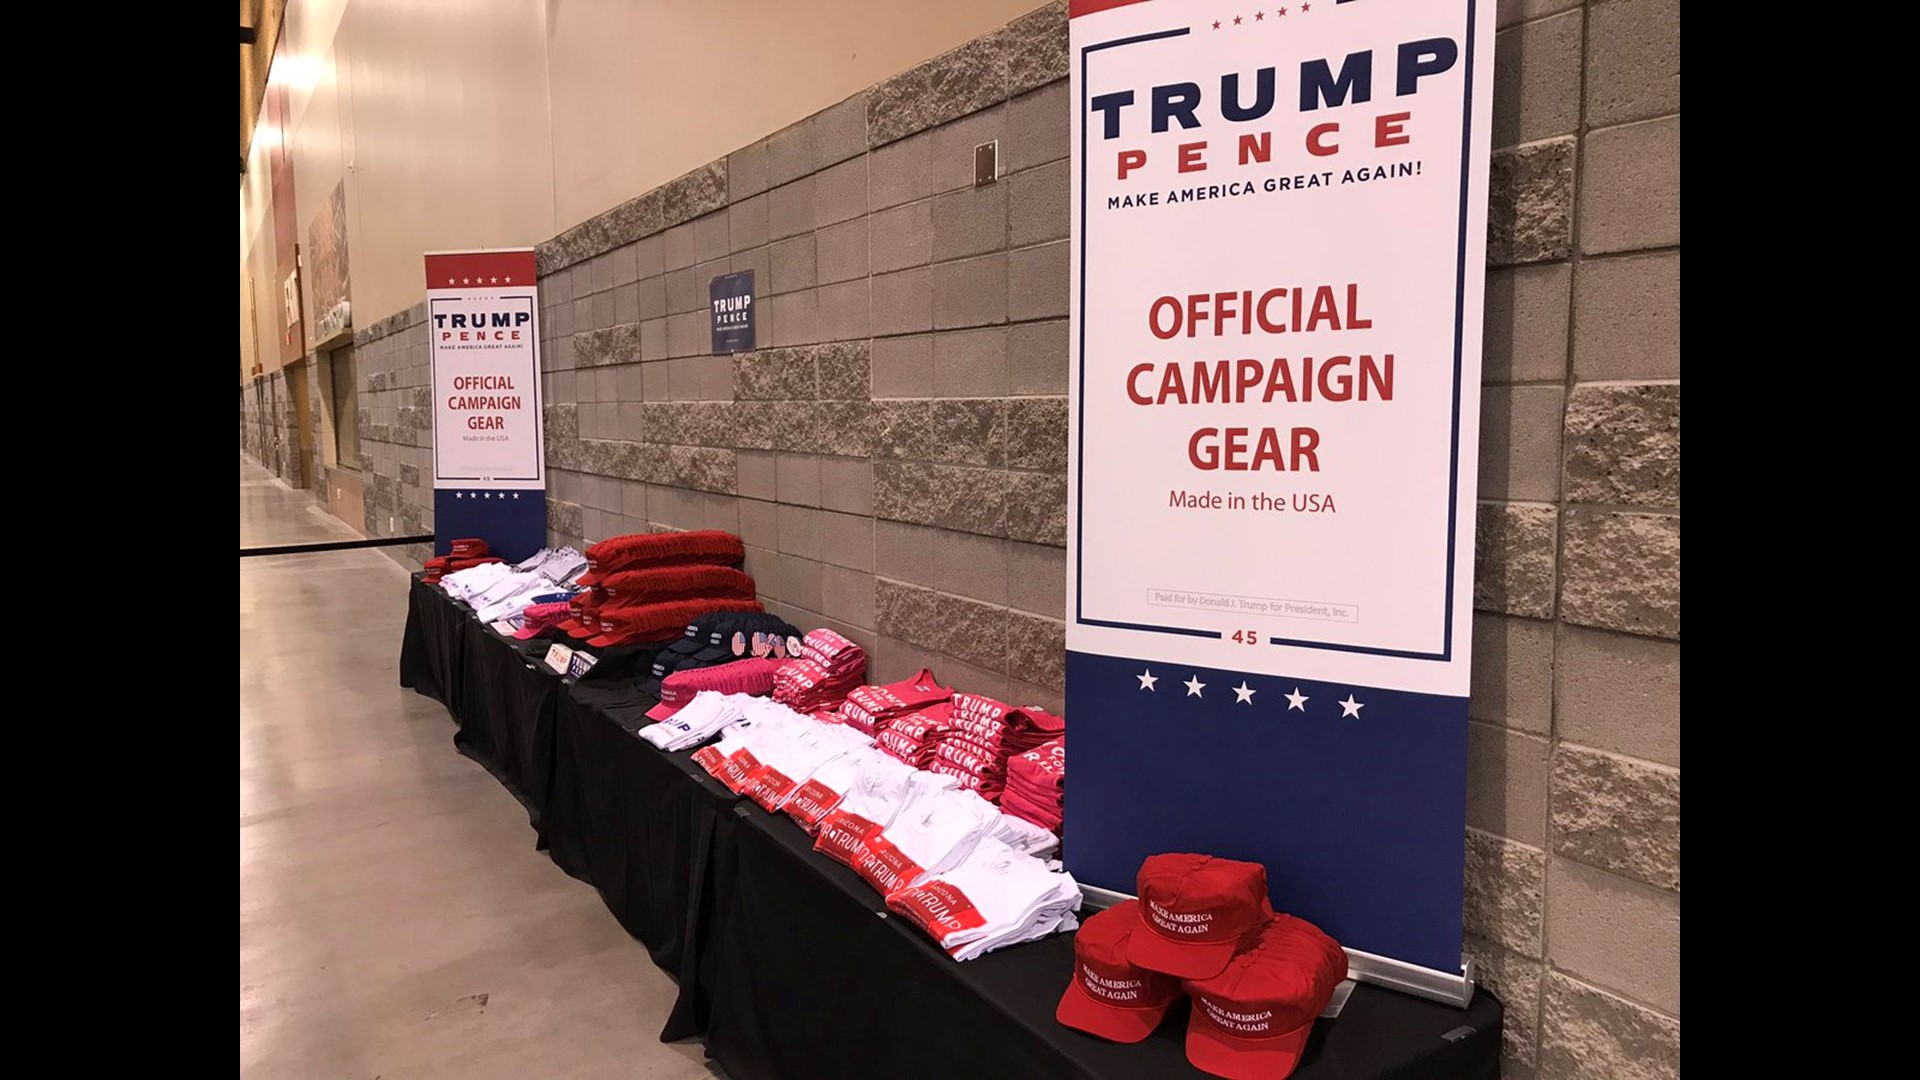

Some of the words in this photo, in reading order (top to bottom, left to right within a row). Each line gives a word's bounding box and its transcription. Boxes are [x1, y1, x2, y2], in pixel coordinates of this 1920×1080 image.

[1091, 37, 1459, 140] TRUMP
[1117, 111, 1412, 180] PENCE
[1108, 192, 1160, 210] MAKE
[1166, 181, 1256, 204] AMERICA
[1263, 172, 1334, 193] GREAT
[1341, 160, 1422, 185] AGAIN!
[713, 295, 751, 313] TRUMP
[1148, 283, 1373, 340] OFFICIAL
[434, 312, 530, 328] TRUMP
[717, 311, 748, 324] PENCE
[442, 330, 521, 341] PENCE
[453, 376, 515, 390] OFFICIAL
[1126, 354, 1395, 407] CAMPAIGN
[447, 396, 521, 410] CAMPAIGN
[467, 416, 504, 430] GEAR
[1187, 426, 1321, 473] GEAR
[1168, 490, 1222, 510] Made
[1227, 492, 1246, 511] in
[1251, 491, 1286, 512] the
[1292, 494, 1337, 514] USA
[1154, 592, 1173, 602] Paid
[1173, 594, 1187, 604] for
[1187, 594, 1199, 605] by
[1199, 596, 1230, 608] Donald
[1238, 599, 1268, 613] Trump
[1269, 602, 1283, 612] for
[1332, 608, 1350, 618] Inc.
[1231, 629, 1258, 646] 45
[953, 693, 1002, 719] TRUMP
[921, 891, 962, 931] TRUMP
[1168, 912, 1214, 923] AMERICA
[1152, 912, 1178, 932] GREAT
[1177, 923, 1209, 935] AGAIN
[1098, 977, 1142, 989] AMERICA
[1106, 990, 1138, 1001] AGAIN
[1225, 1010, 1273, 1022] AMERICA
[1235, 1021, 1270, 1032] AGAIN
